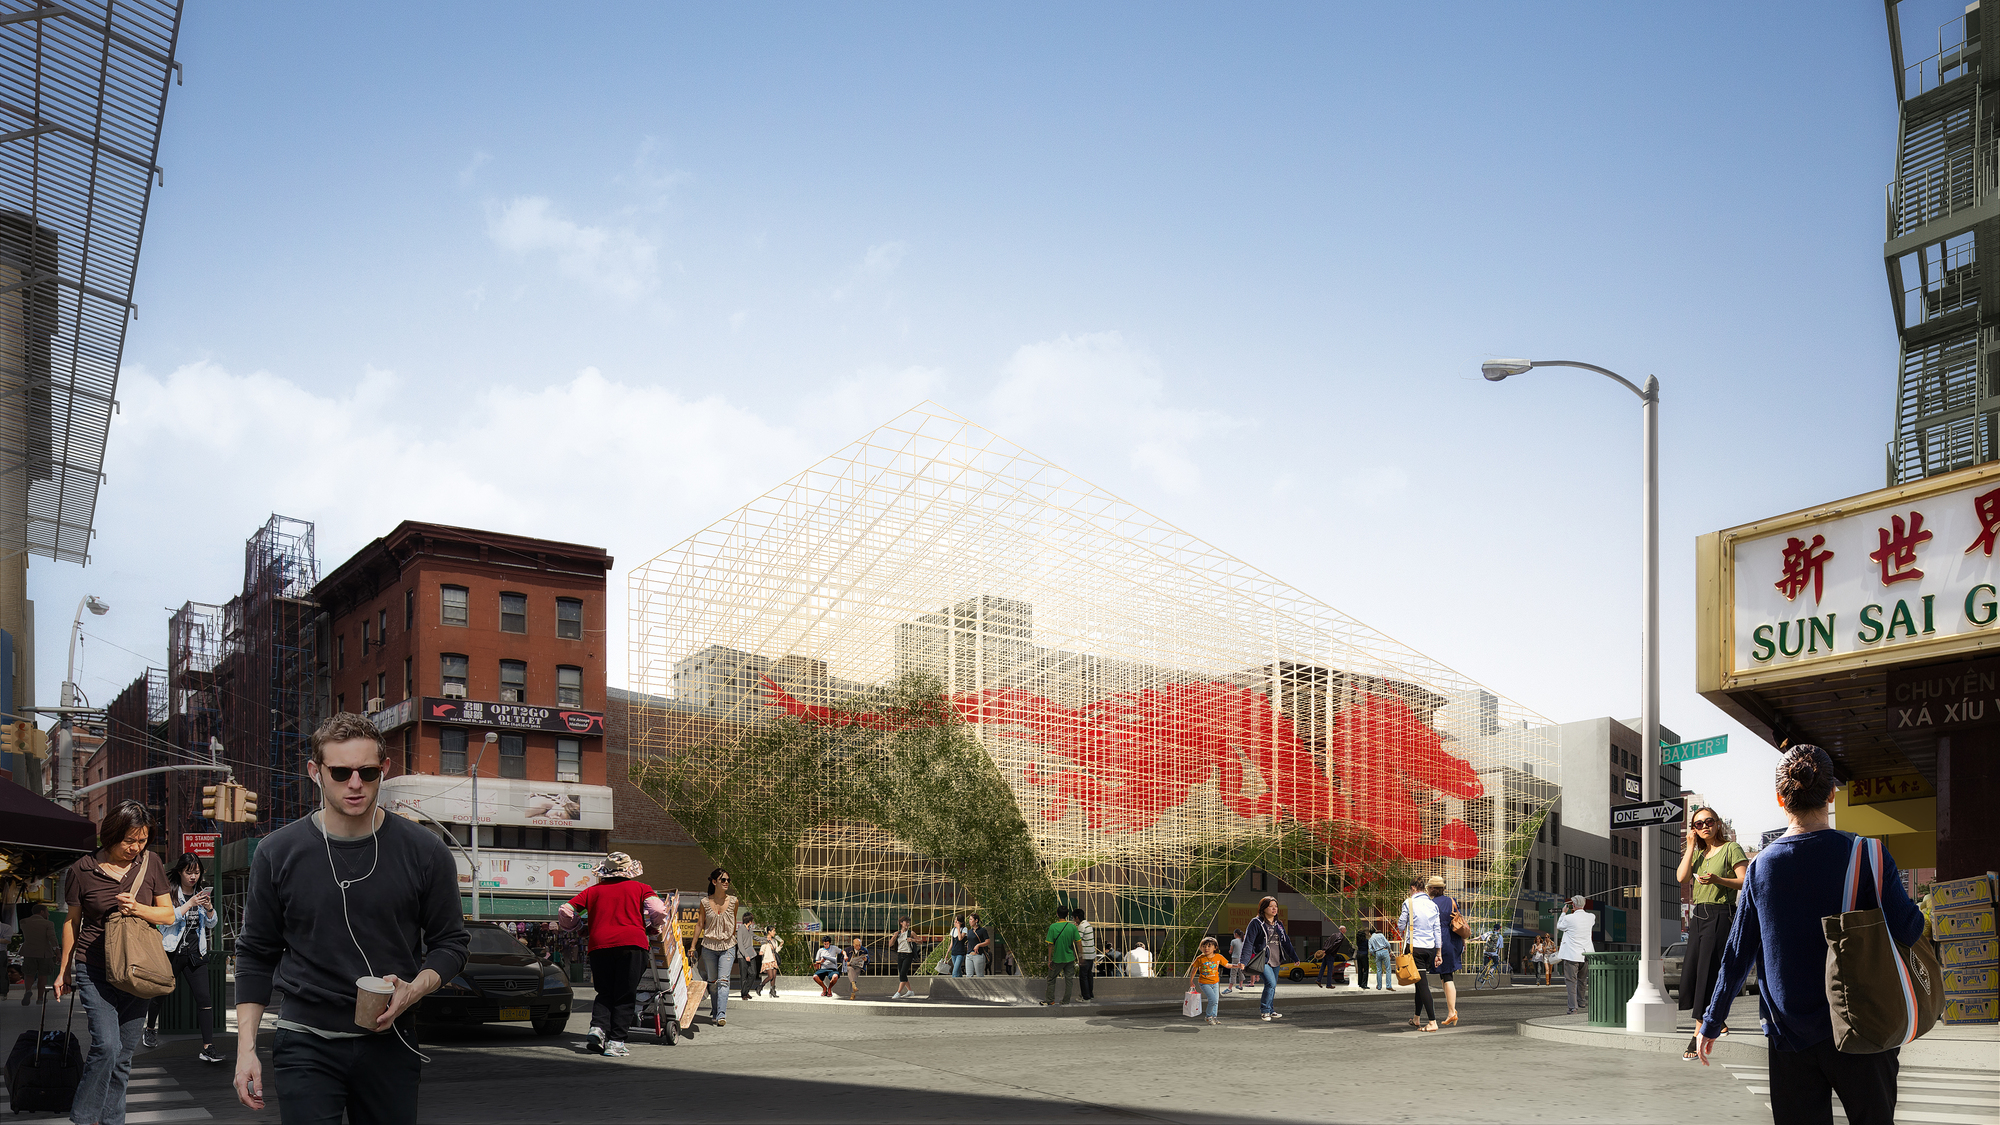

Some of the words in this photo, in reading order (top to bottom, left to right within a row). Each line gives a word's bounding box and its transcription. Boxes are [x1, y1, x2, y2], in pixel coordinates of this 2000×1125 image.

[1751, 613, 1837, 663] SUN
[1857, 594, 1935, 645] SAI
[1895, 667, 1995, 702] CHUYÊN
[490, 704, 549, 718] OPT2GO
[1898, 701, 1933, 728] XÁ
[1943, 697, 1984, 724] XÍU
[498, 714, 542, 725] OUTLET
[1663, 740, 1713, 762] BAXTER
[1715, 737, 1725, 747] ST
[1626, 780, 1639, 792] ONE
[1616, 810, 1639, 821] ONE
[1652, 806, 1676, 817] WAY
[1951, 887, 1970, 897] BONITA
[1956, 919, 1975, 928] BONITA
[1964, 947, 1982, 956] BONITA
[1963, 975, 1981, 984] BONITA
[1965, 1005, 1983, 1013] BONITA
